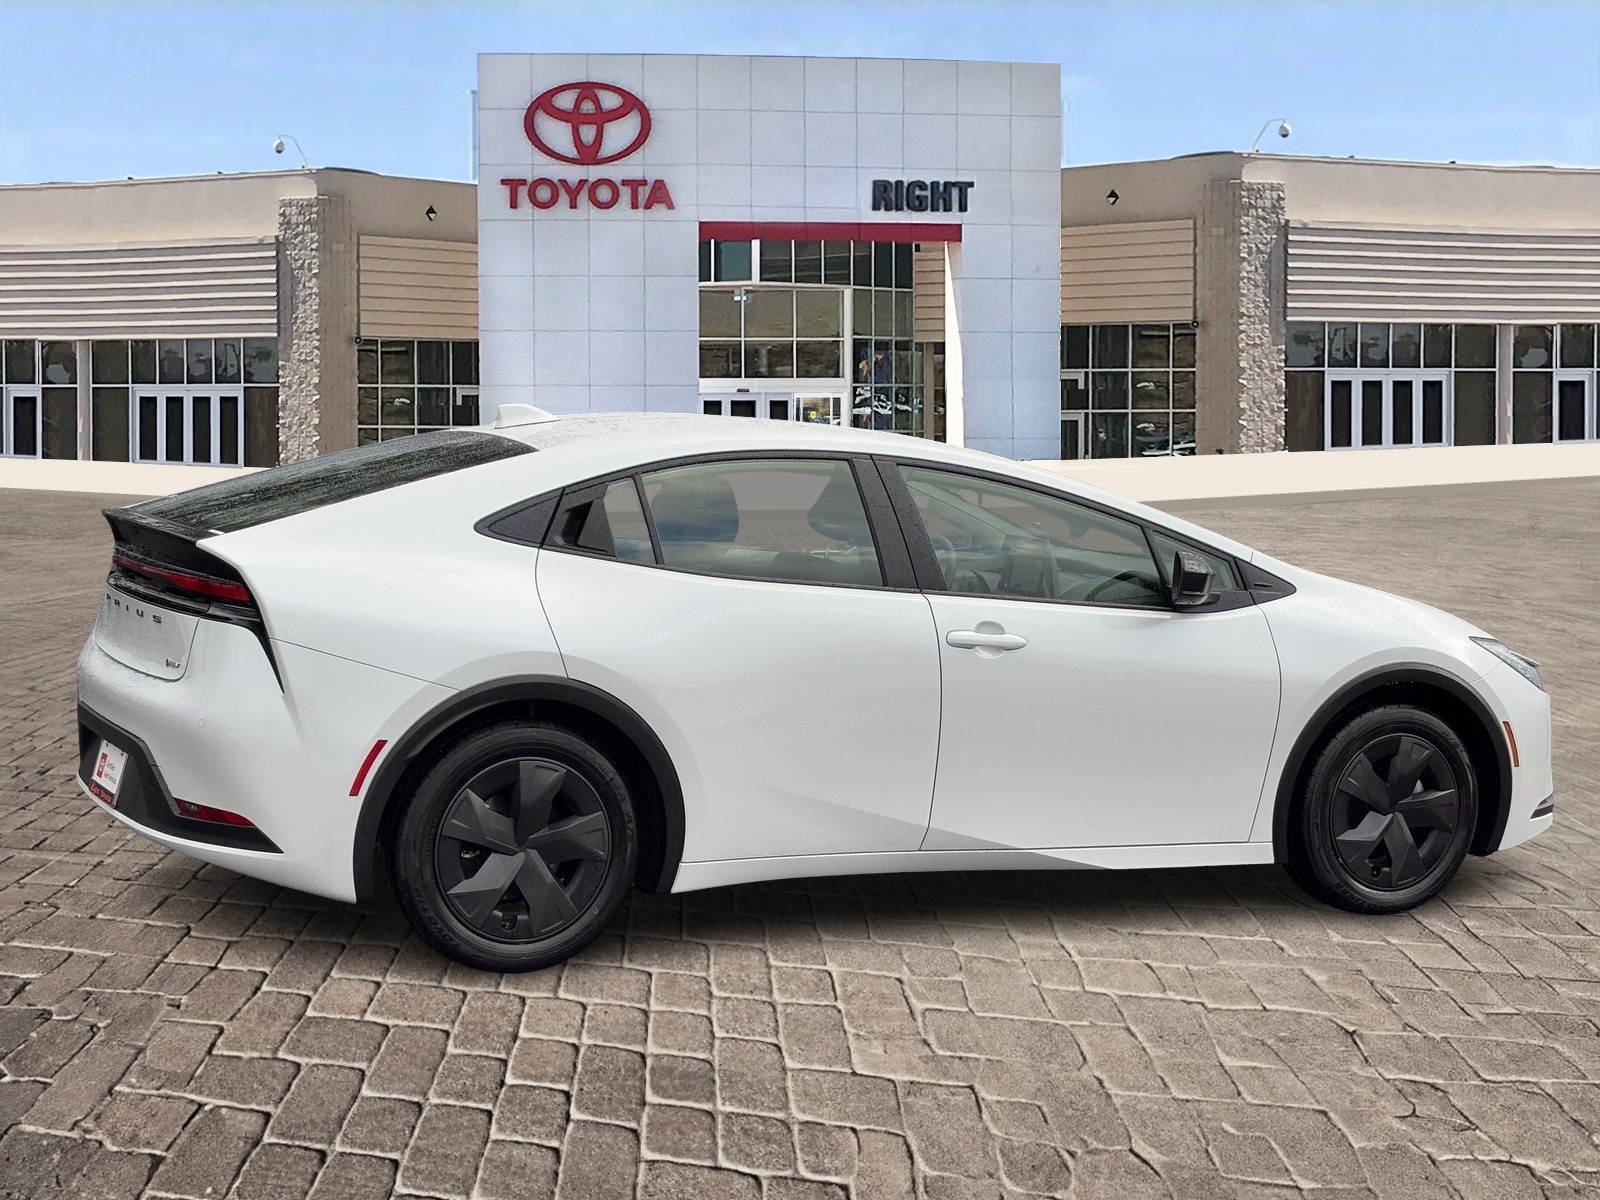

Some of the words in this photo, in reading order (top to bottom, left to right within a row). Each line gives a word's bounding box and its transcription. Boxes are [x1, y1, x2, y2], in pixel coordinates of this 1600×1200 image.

[500, 177, 675, 210] TOYOTA
[872, 180, 975, 212] RIGHT
[106, 593, 162, 624] PRIUS
